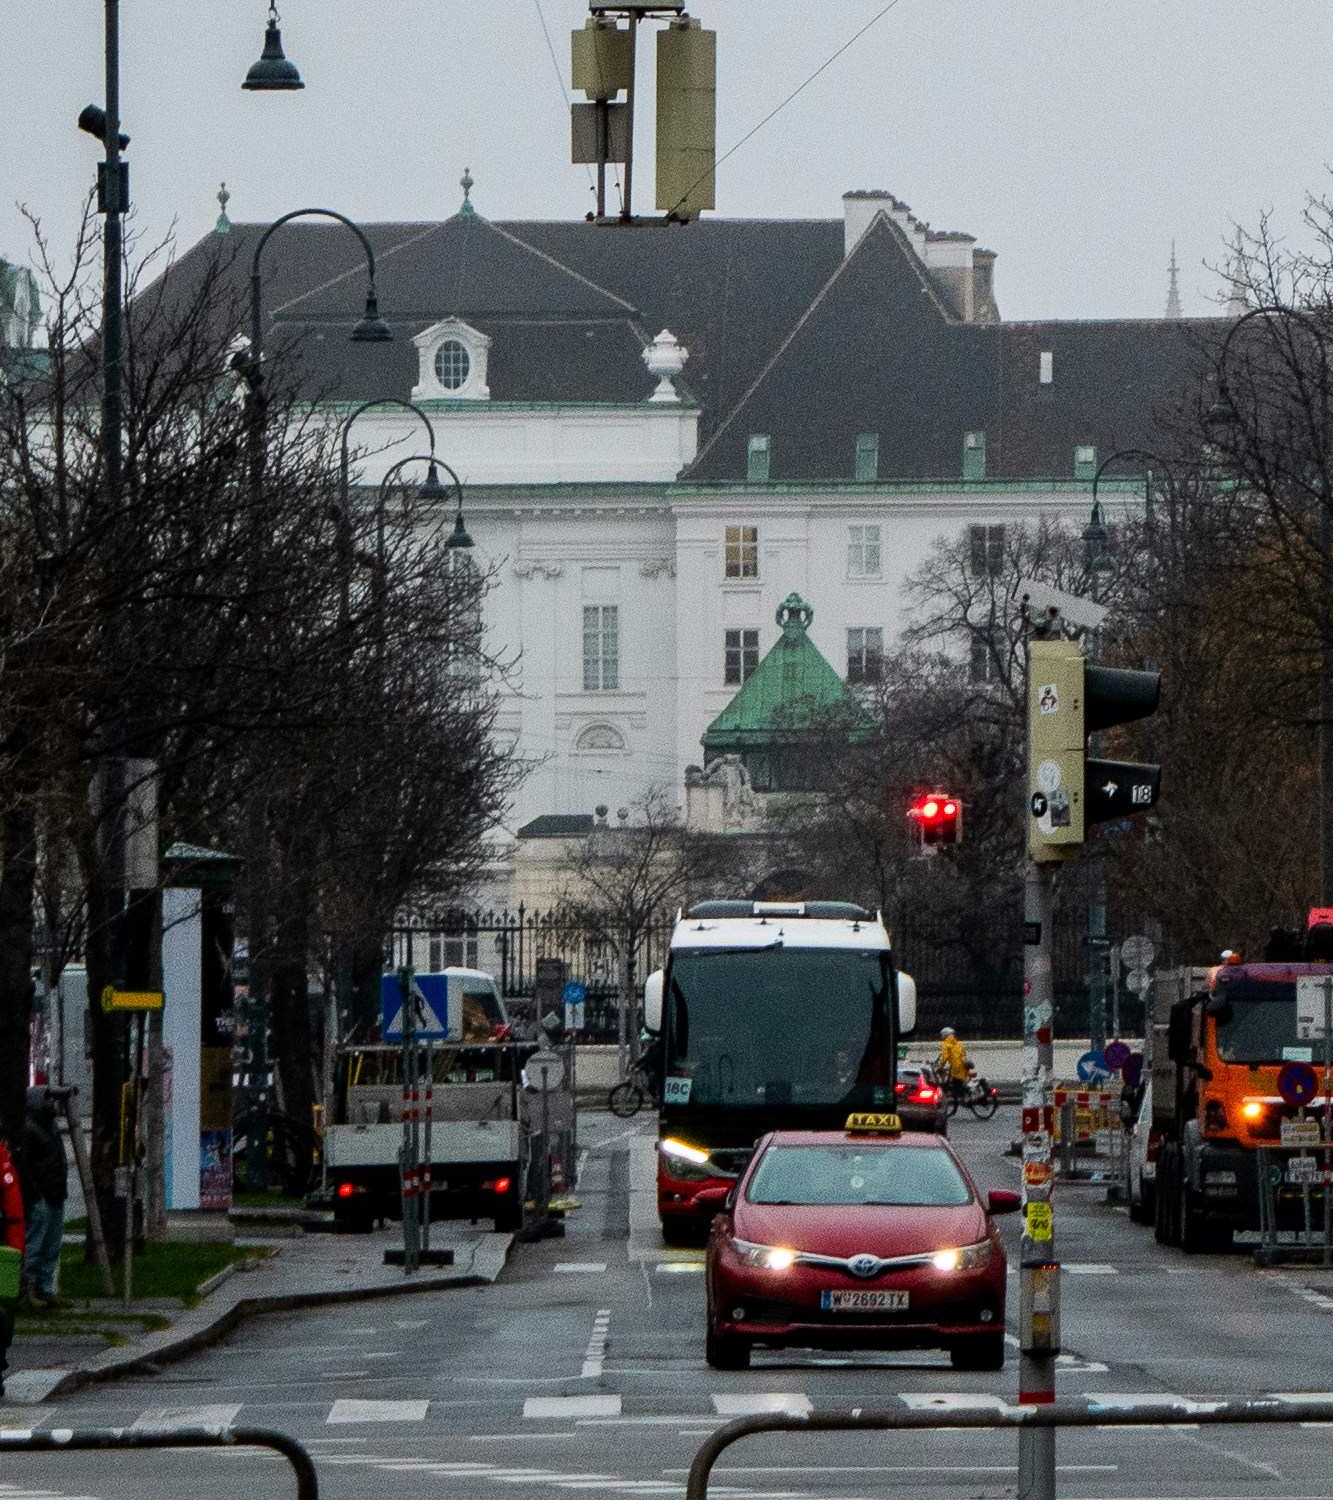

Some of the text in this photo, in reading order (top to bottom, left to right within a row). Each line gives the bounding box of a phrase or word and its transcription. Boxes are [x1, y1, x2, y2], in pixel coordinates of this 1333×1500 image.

[1132, 784, 1151, 804] 18
[666, 1078, 690, 1095] 18C
[853, 1114, 896, 1127] TAXI
